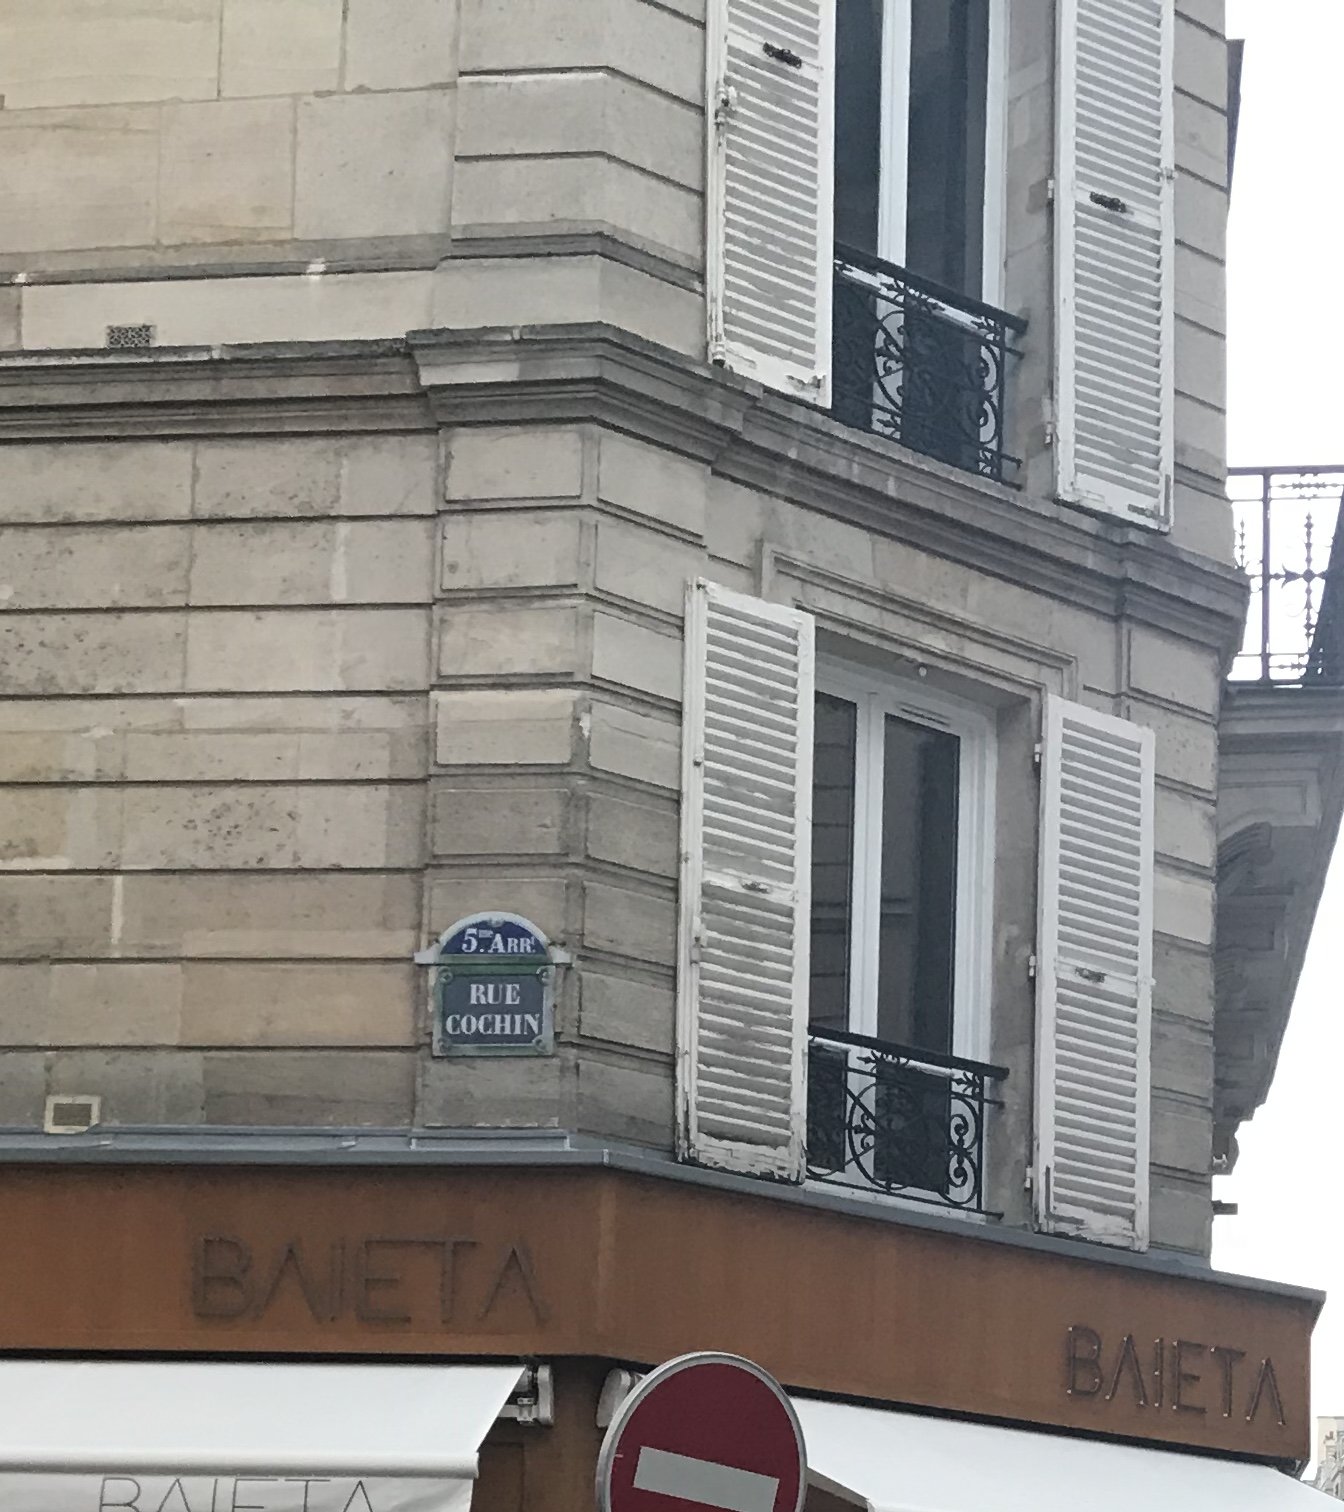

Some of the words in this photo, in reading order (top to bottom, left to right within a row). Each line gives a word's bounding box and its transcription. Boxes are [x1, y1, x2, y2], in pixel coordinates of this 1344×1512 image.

[469, 983, 521, 1005] RUE
[445, 1013, 540, 1036] COCHIN
[192, 1233, 551, 1326] BAIETA
[1065, 1325, 1287, 1427] BAIETA
